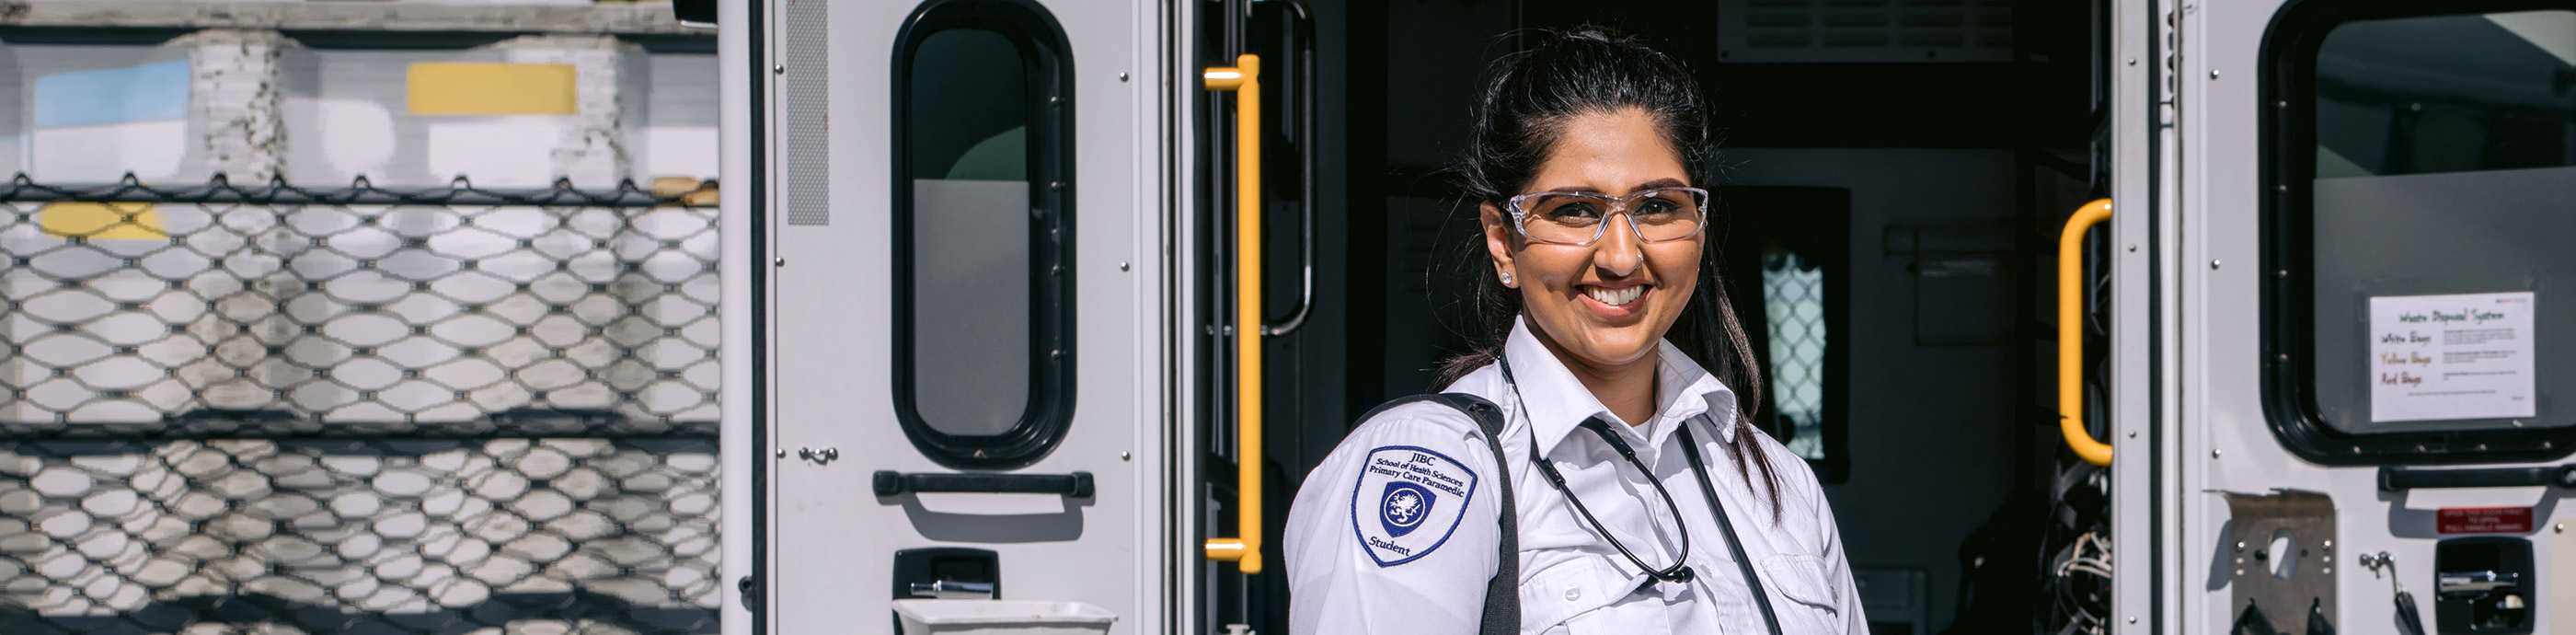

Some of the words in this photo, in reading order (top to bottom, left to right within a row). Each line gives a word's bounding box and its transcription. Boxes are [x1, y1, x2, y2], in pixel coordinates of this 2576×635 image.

[2400, 312, 2427, 322] Waste
[2432, 308, 2467, 324] Disposal
[2471, 308, 2504, 324] System
[2381, 333, 2405, 344] White
[2409, 331, 2431, 346] Bags
[2381, 353, 2407, 365] Yellow
[2410, 352, 2432, 367] Bags
[2381, 373, 2398, 385] Red
[2401, 372, 2422, 387] Bags
[1409, 453, 1435, 466] JIBC
[1375, 457, 1400, 466] School
[1400, 462, 1409, 470] of
[1409, 464, 1431, 476] Health
[1431, 470, 1464, 488] Sciences
[1369, 465, 1401, 479] Primary
[1402, 470, 1421, 483] Care
[1421, 476, 1465, 498] Paramedic
[1369, 537, 1410, 556] Student
